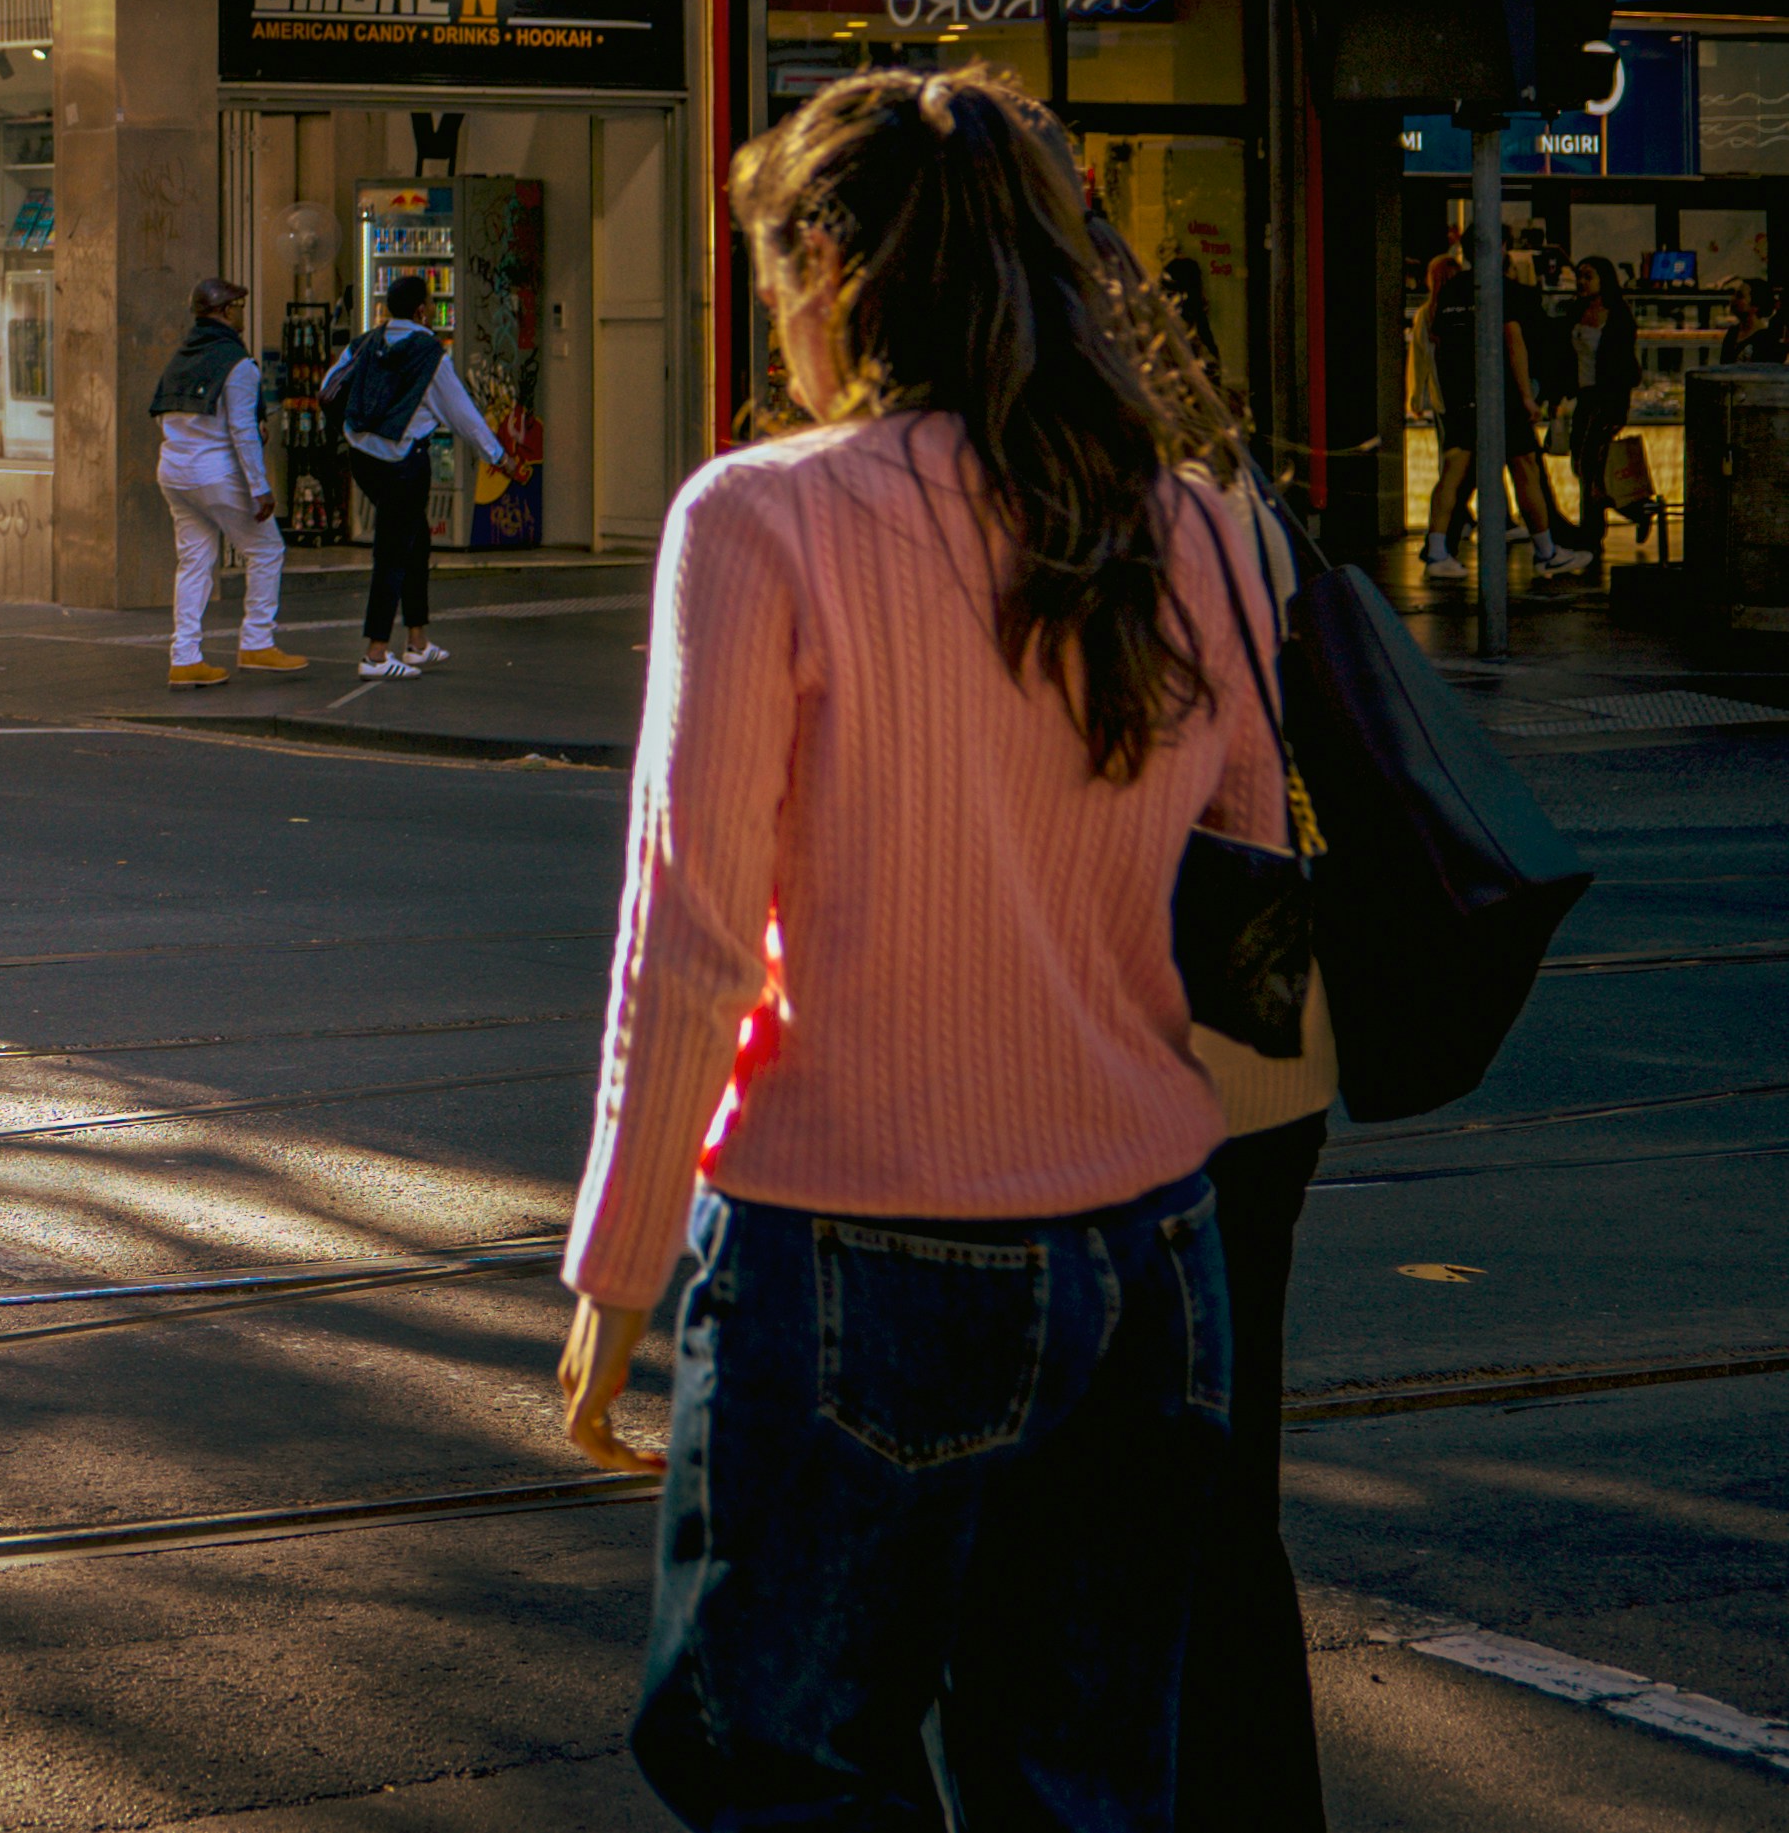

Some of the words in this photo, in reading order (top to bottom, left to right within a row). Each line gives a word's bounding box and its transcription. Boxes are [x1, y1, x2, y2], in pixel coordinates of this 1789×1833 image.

[251, 21, 349, 42] AMERICAN
[353, 24, 418, 43] CANDY
[432, 26, 500, 46] DRINKS
[516, 28, 593, 48] HOOKAH
[1540, 134, 1600, 155] NIGIRI
